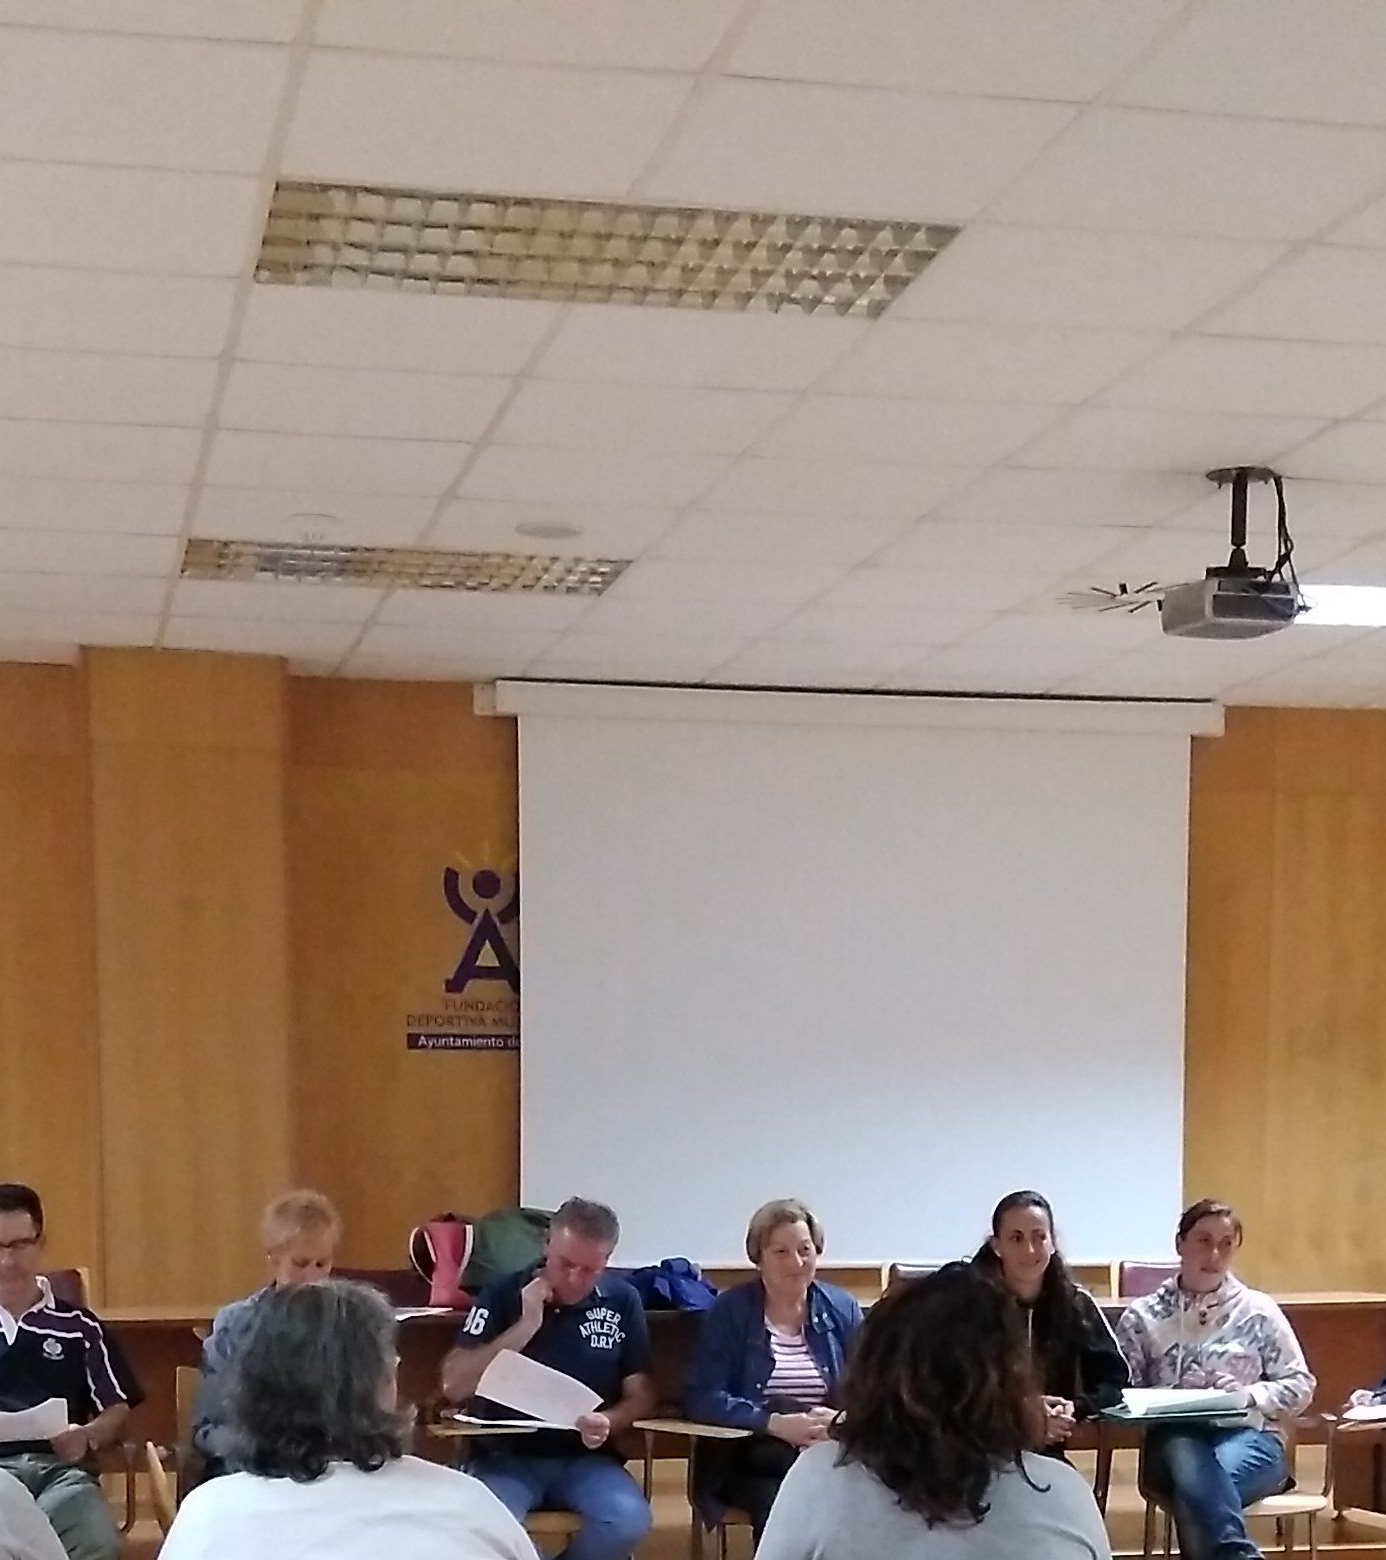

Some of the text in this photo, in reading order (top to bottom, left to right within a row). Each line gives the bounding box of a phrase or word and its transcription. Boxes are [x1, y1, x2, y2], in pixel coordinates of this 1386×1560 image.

[406, 1014, 487, 1027] DEPORTIVA
[418, 1035, 504, 1048] Ayuntamiento
[585, 1307, 622, 1325] SUPER
[579, 1319, 626, 1343] ATHLETIC
